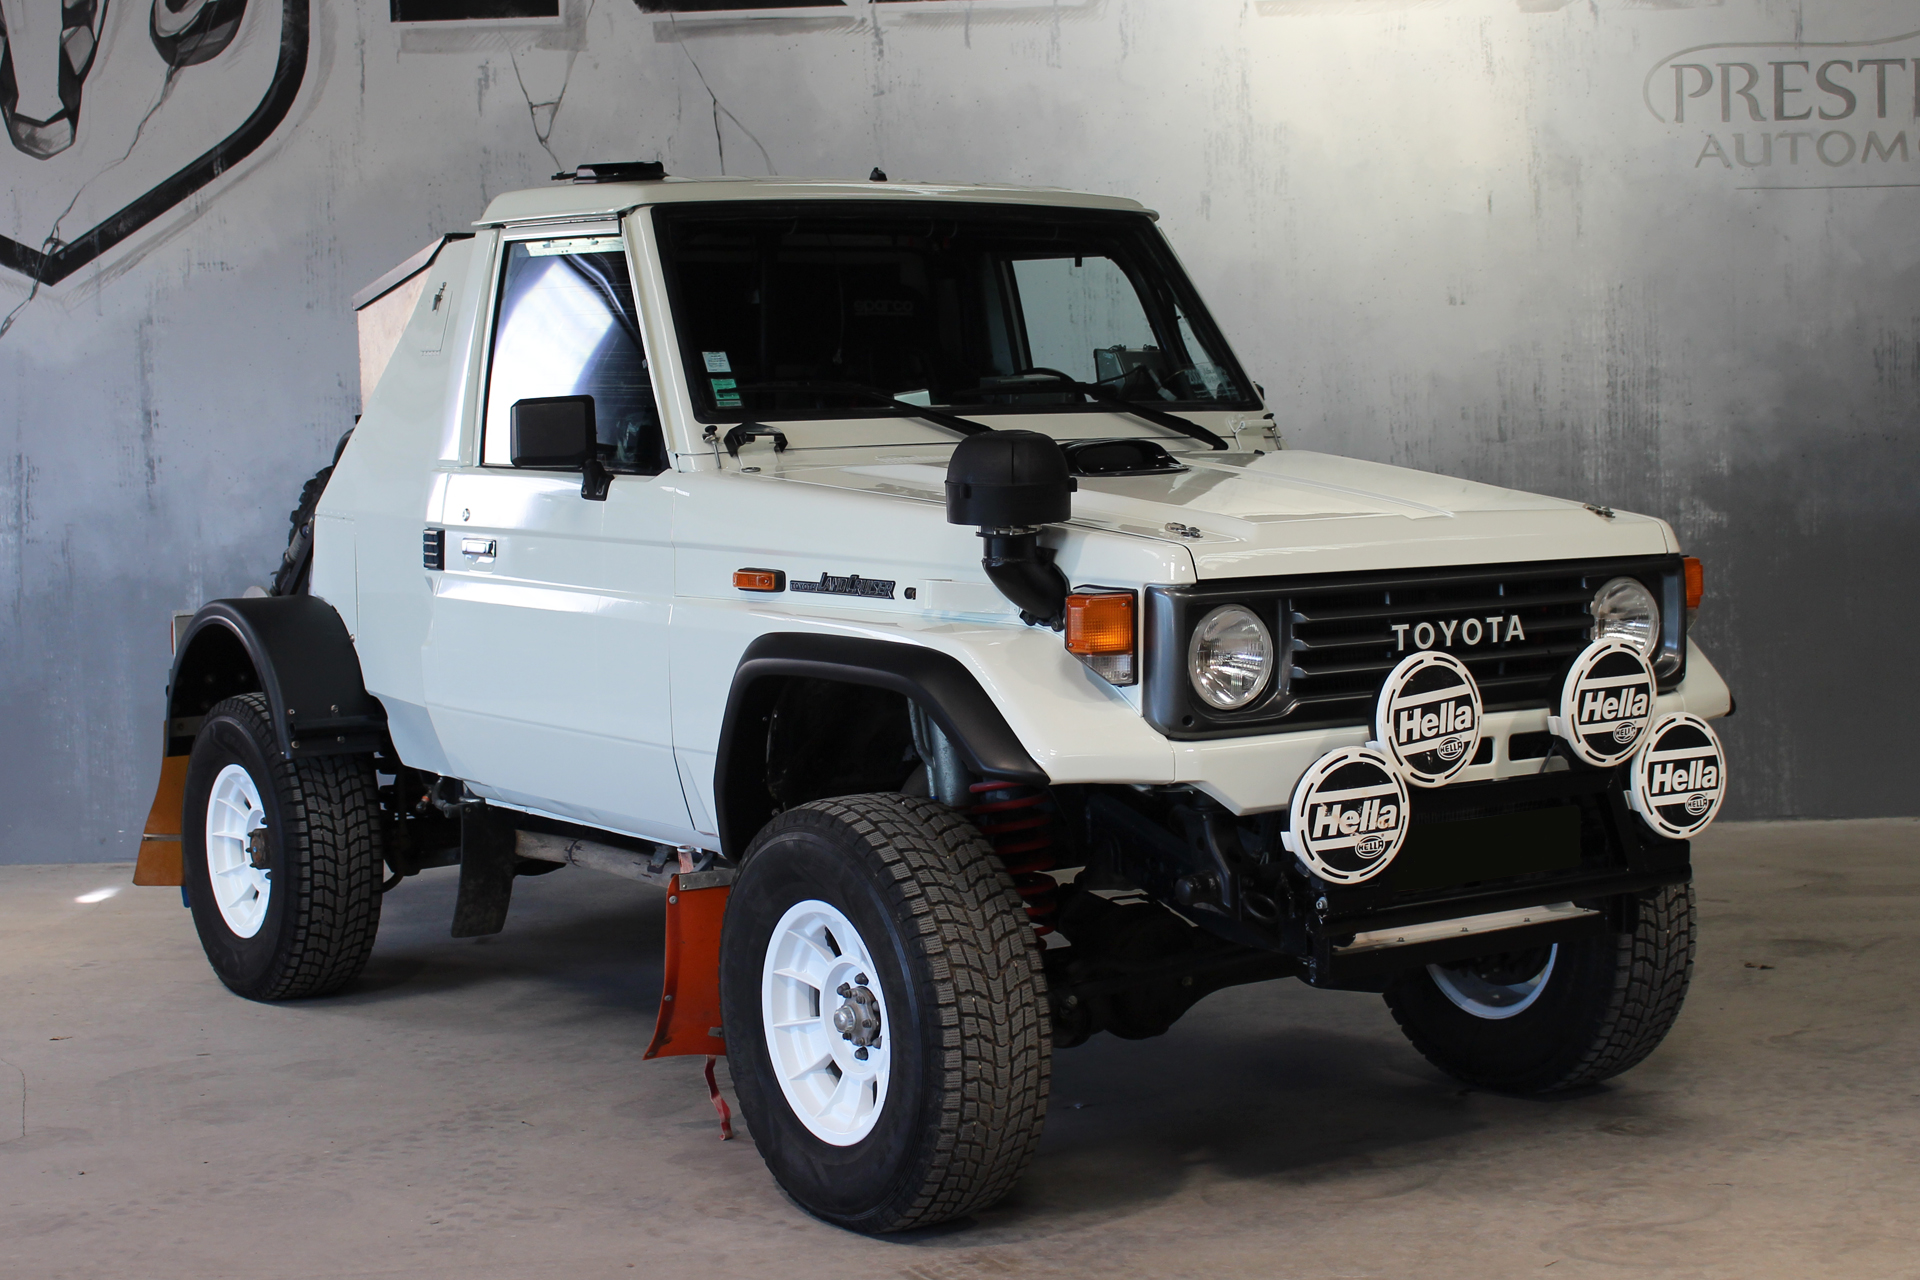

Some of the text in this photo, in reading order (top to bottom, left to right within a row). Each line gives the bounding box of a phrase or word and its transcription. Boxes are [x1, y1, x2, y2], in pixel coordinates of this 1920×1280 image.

[1694, 130, 1920, 170] AUTOM
[791, 581, 816, 592] TOYOTA
[1391, 614, 1525, 651] TOYOTA
[1399, 700, 1472, 743] Hella
[1580, 687, 1648, 722] Hella
[1440, 741, 1463, 753] HELLA
[1651, 759, 1718, 794] Hella
[1312, 799, 1397, 838] Hella
[1687, 798, 1708, 808] HELLA
[1358, 840, 1384, 852] HELLA
